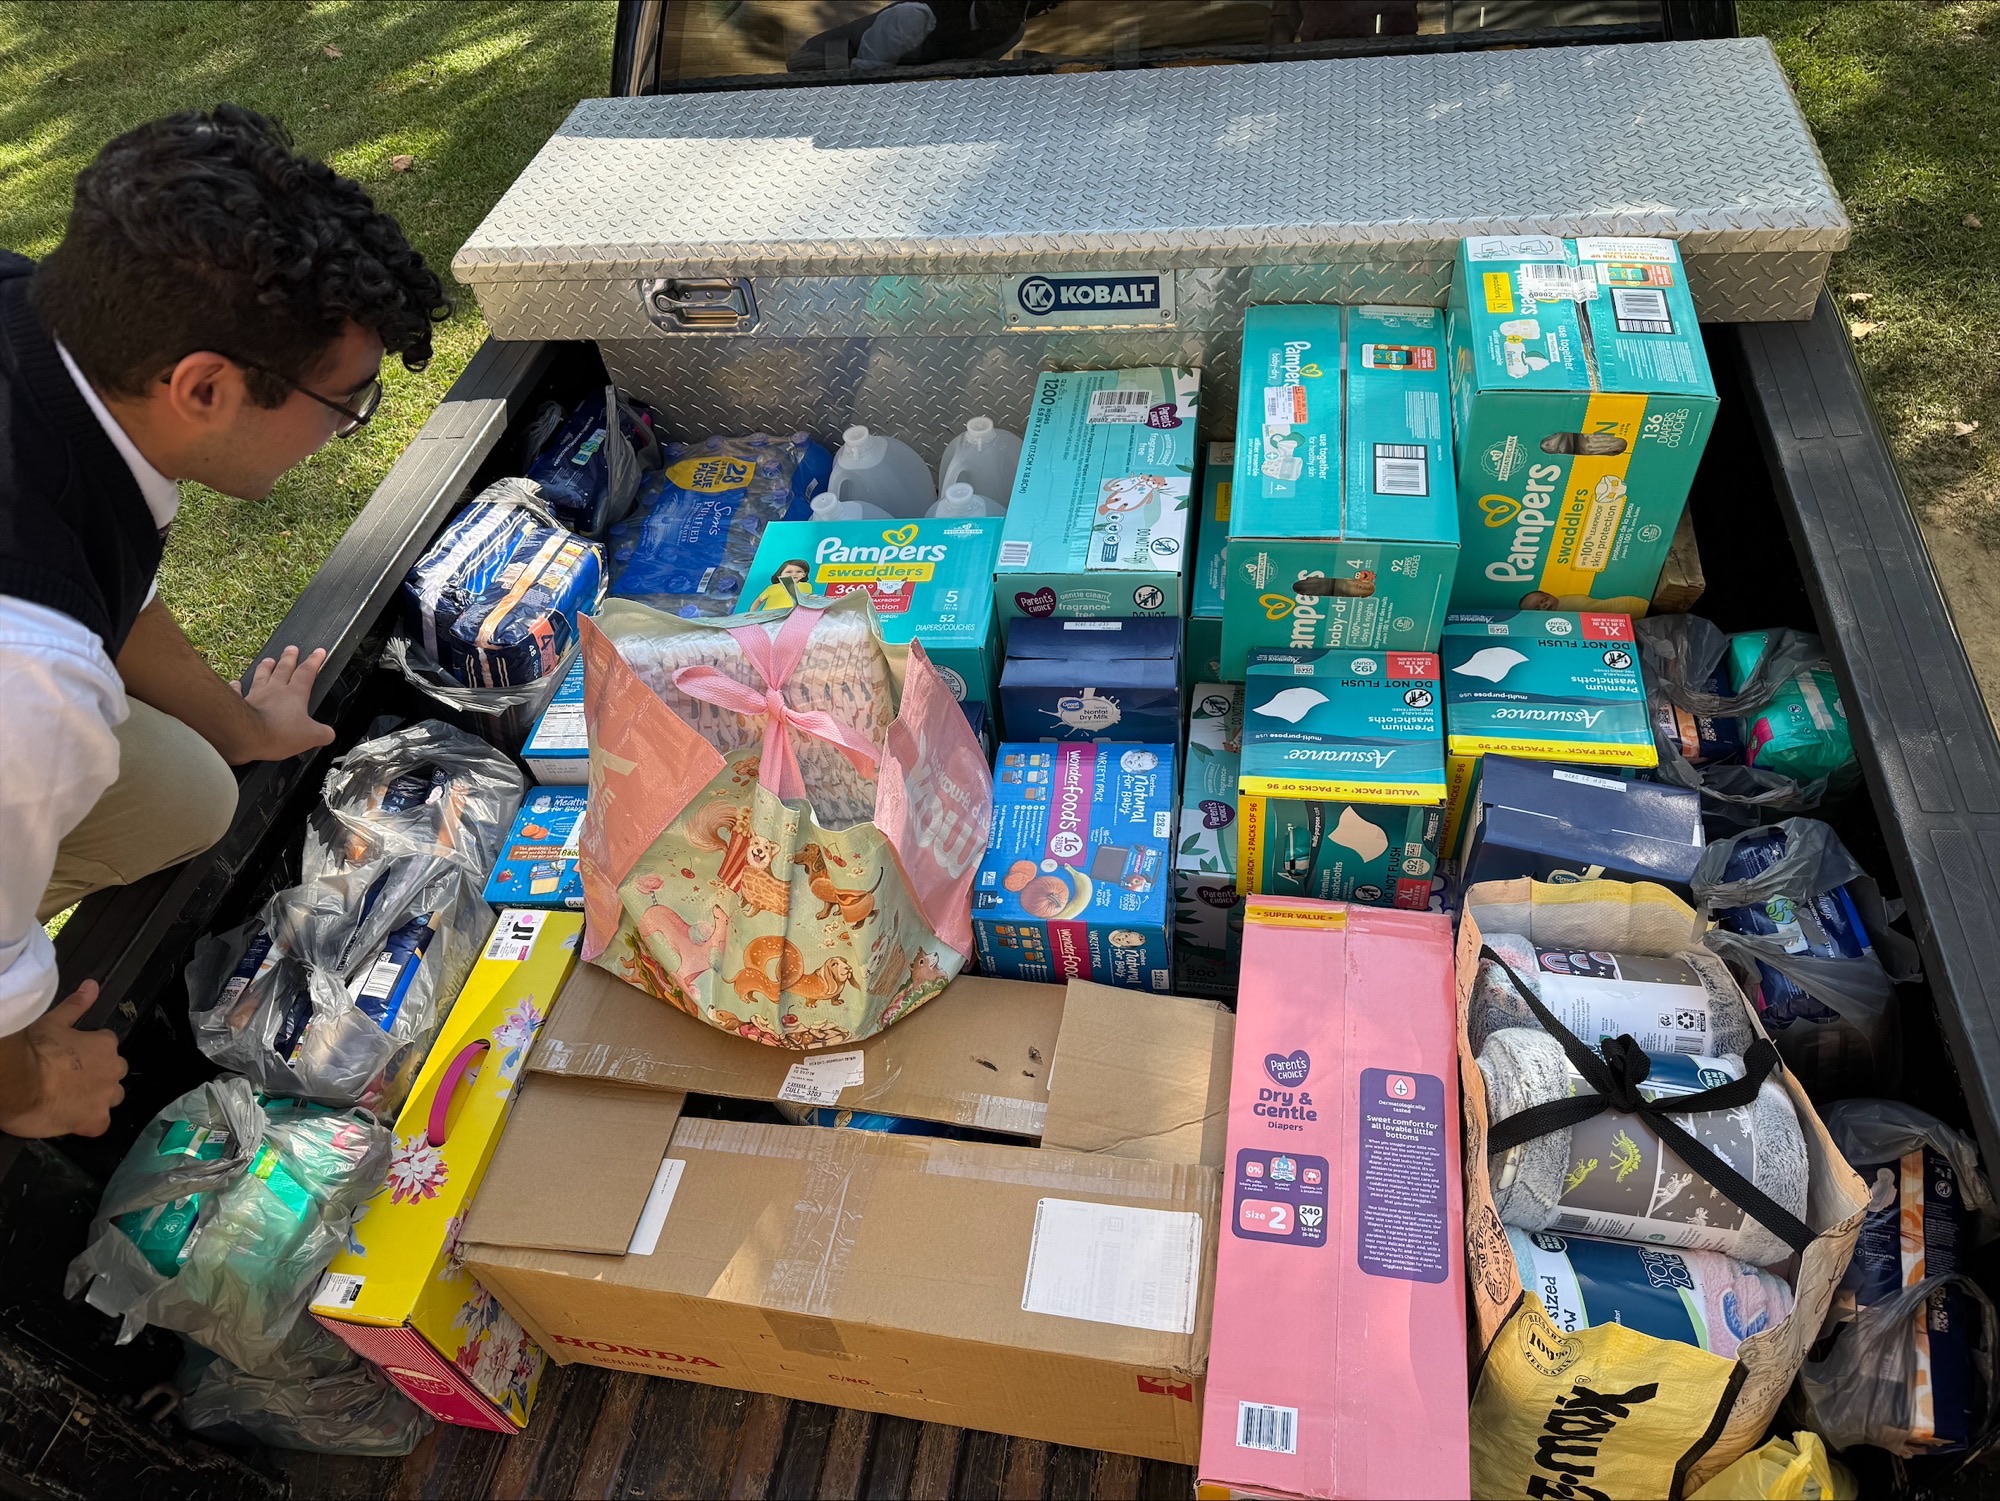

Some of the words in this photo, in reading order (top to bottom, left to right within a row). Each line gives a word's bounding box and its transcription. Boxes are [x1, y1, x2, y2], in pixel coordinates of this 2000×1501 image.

[1060, 283, 1155, 304] KOBALT
[1558, 325, 1567, 340] use
[1560, 340, 1575, 371] together
[1269, 352, 1281, 381] baby-dry
[1284, 341, 1312, 388] Pampers
[1040, 378, 1059, 406] 1200
[1158, 406, 1173, 428] Parent's
[1641, 414, 1663, 440] 136
[1656, 411, 1677, 445] DIAPERS
[1667, 408, 1690, 448] COUCHES
[1319, 433, 1327, 447] use
[1147, 432, 1157, 465] fragrance-
[1307, 445, 1317, 466] healthy
[1318, 447, 1329, 480] together
[1501, 438, 1515, 480] PEDIATRICIAN
[691, 462, 708, 488] PACK
[700, 459, 722, 489] VALUE
[721, 462, 748, 484] 28
[1308, 466, 1316, 478] skin
[689, 500, 715, 543] PURIFIED
[1485, 463, 1562, 582] Pampers
[1556, 488, 1589, 565] swaddlers
[1589, 504, 1603, 536] LEAKPROOF
[1591, 549, 1601, 567] skin
[1598, 504, 1617, 550] protection
[1611, 532, 1625, 561] protection
[1624, 503, 1635, 518] peau
[815, 537, 948, 565] Pampers
[1256, 553, 1267, 589] PEDIATRICIAN
[1347, 559, 1361, 568] 4
[1390, 559, 1404, 572] 92
[1402, 556, 1413, 577] DIAPERS
[1409, 554, 1421, 578] COUCHES
[827, 566, 924, 579] swaddlers
[945, 590, 958, 604] 5
[1020, 592, 1054, 607] Parent's
[1060, 591, 1084, 601] gentle
[1085, 590, 1107, 600] clean
[1028, 603, 1052, 614] CHOICE
[1059, 603, 1111, 612] fragrance-
[1365, 603, 1374, 621] nights
[939, 614, 956, 623] 52
[915, 623, 976, 633] DIAPERS/COUCHES
[1599, 626, 1620, 637] XL
[1538, 639, 1577, 649] FLUSH
[1582, 640, 1608, 649] NOT
[1612, 641, 1630, 650] DO
[1353, 665, 1375, 673] 192
[1404, 665, 1425, 675] XL
[1341, 679, 1380, 688] FLUSH
[1384, 680, 1410, 688] NOT
[1414, 680, 1433, 688] DO
[1571, 676, 1637, 686] washcloths
[1585, 684, 1639, 693] Premium
[1474, 691, 1528, 700] multi-purpose
[1079, 714, 1092, 722] Dry
[1093, 713, 1109, 721] Milk
[1368, 716, 1434, 725] washcloths
[1495, 708, 1605, 729] Assurance
[1381, 724, 1434, 732] Premium
[1269, 733, 1322, 742] multi-purpose
[1289, 749, 1397, 769] Assurance
[1598, 749, 1634, 757] VALUE
[1095, 751, 1108, 783] VARIETY
[1059, 750, 1084, 829] wonderfoods
[1122, 774, 1134, 790] for
[1148, 774, 1156, 797] Gerber
[1298, 785, 1332, 793] PACKS
[1450, 783, 1461, 808] PACKS
[1457, 763, 1466, 773] 96
[1094, 784, 1106, 803] PACK
[1130, 775, 1149, 823] Natural
[1385, 788, 1420, 796] VALUE
[564, 806, 584, 814] Baby
[1118, 790, 1134, 816] Baby
[1249, 802, 1258, 812] 96
[1156, 813, 1166, 827] 128
[1209, 801, 1219, 827] Parent's
[1248, 813, 1257, 823] OF
[1247, 824, 1257, 846] PACKS
[1311, 816, 1321, 848] multi-purpose
[1064, 837, 1079, 852] 16
[1388, 846, 1402, 872] FLUSH
[1406, 859, 1418, 873] 192
[1319, 869, 1331, 899] Premium
[1385, 874, 1398, 891] NOT
[1202, 889, 1238, 899] Parent's
[1383, 892, 1395, 904] DO
[1399, 887, 1413, 901] XL
[1263, 911, 1294, 920] SUPER
[1296, 912, 1327, 921] VALUE
[1114, 947, 1125, 960] for
[1115, 960, 1126, 978] Baby
[1125, 949, 1142, 984] Natural
[1271, 1057, 1307, 1072] Parent's
[1278, 1070, 1304, 1080] CHOICE
[1258, 1088, 1294, 1107] Dry
[1298, 1092, 1313, 1106] &
[1253, 1103, 1318, 1122] Gentle
[1378, 1100, 1426, 1111] Dermatologically
[1268, 1120, 1304, 1133] Diapers
[1366, 1115, 1391, 1124] Sweet
[1392, 1118, 1424, 1128] comfort
[1426, 1122, 1438, 1130] for
[1383, 1124, 1412, 1133] lovable
[1413, 1128, 1434, 1136] little
[1386, 1131, 1419, 1142] bottoms
[1247, 1166, 1262, 1174] 0%
[1245, 1210, 1266, 1220] Size
[1268, 1206, 1287, 1230] 2
[1301, 1207, 1320, 1216] 240
[1643, 1251, 1669, 1287] YOUR
[1666, 1252, 1693, 1289] ZONE
[550, 1334, 725, 1369] HONDA
[592, 1355, 655, 1371] GENUINE
[656, 1365, 702, 1376] PARTS
